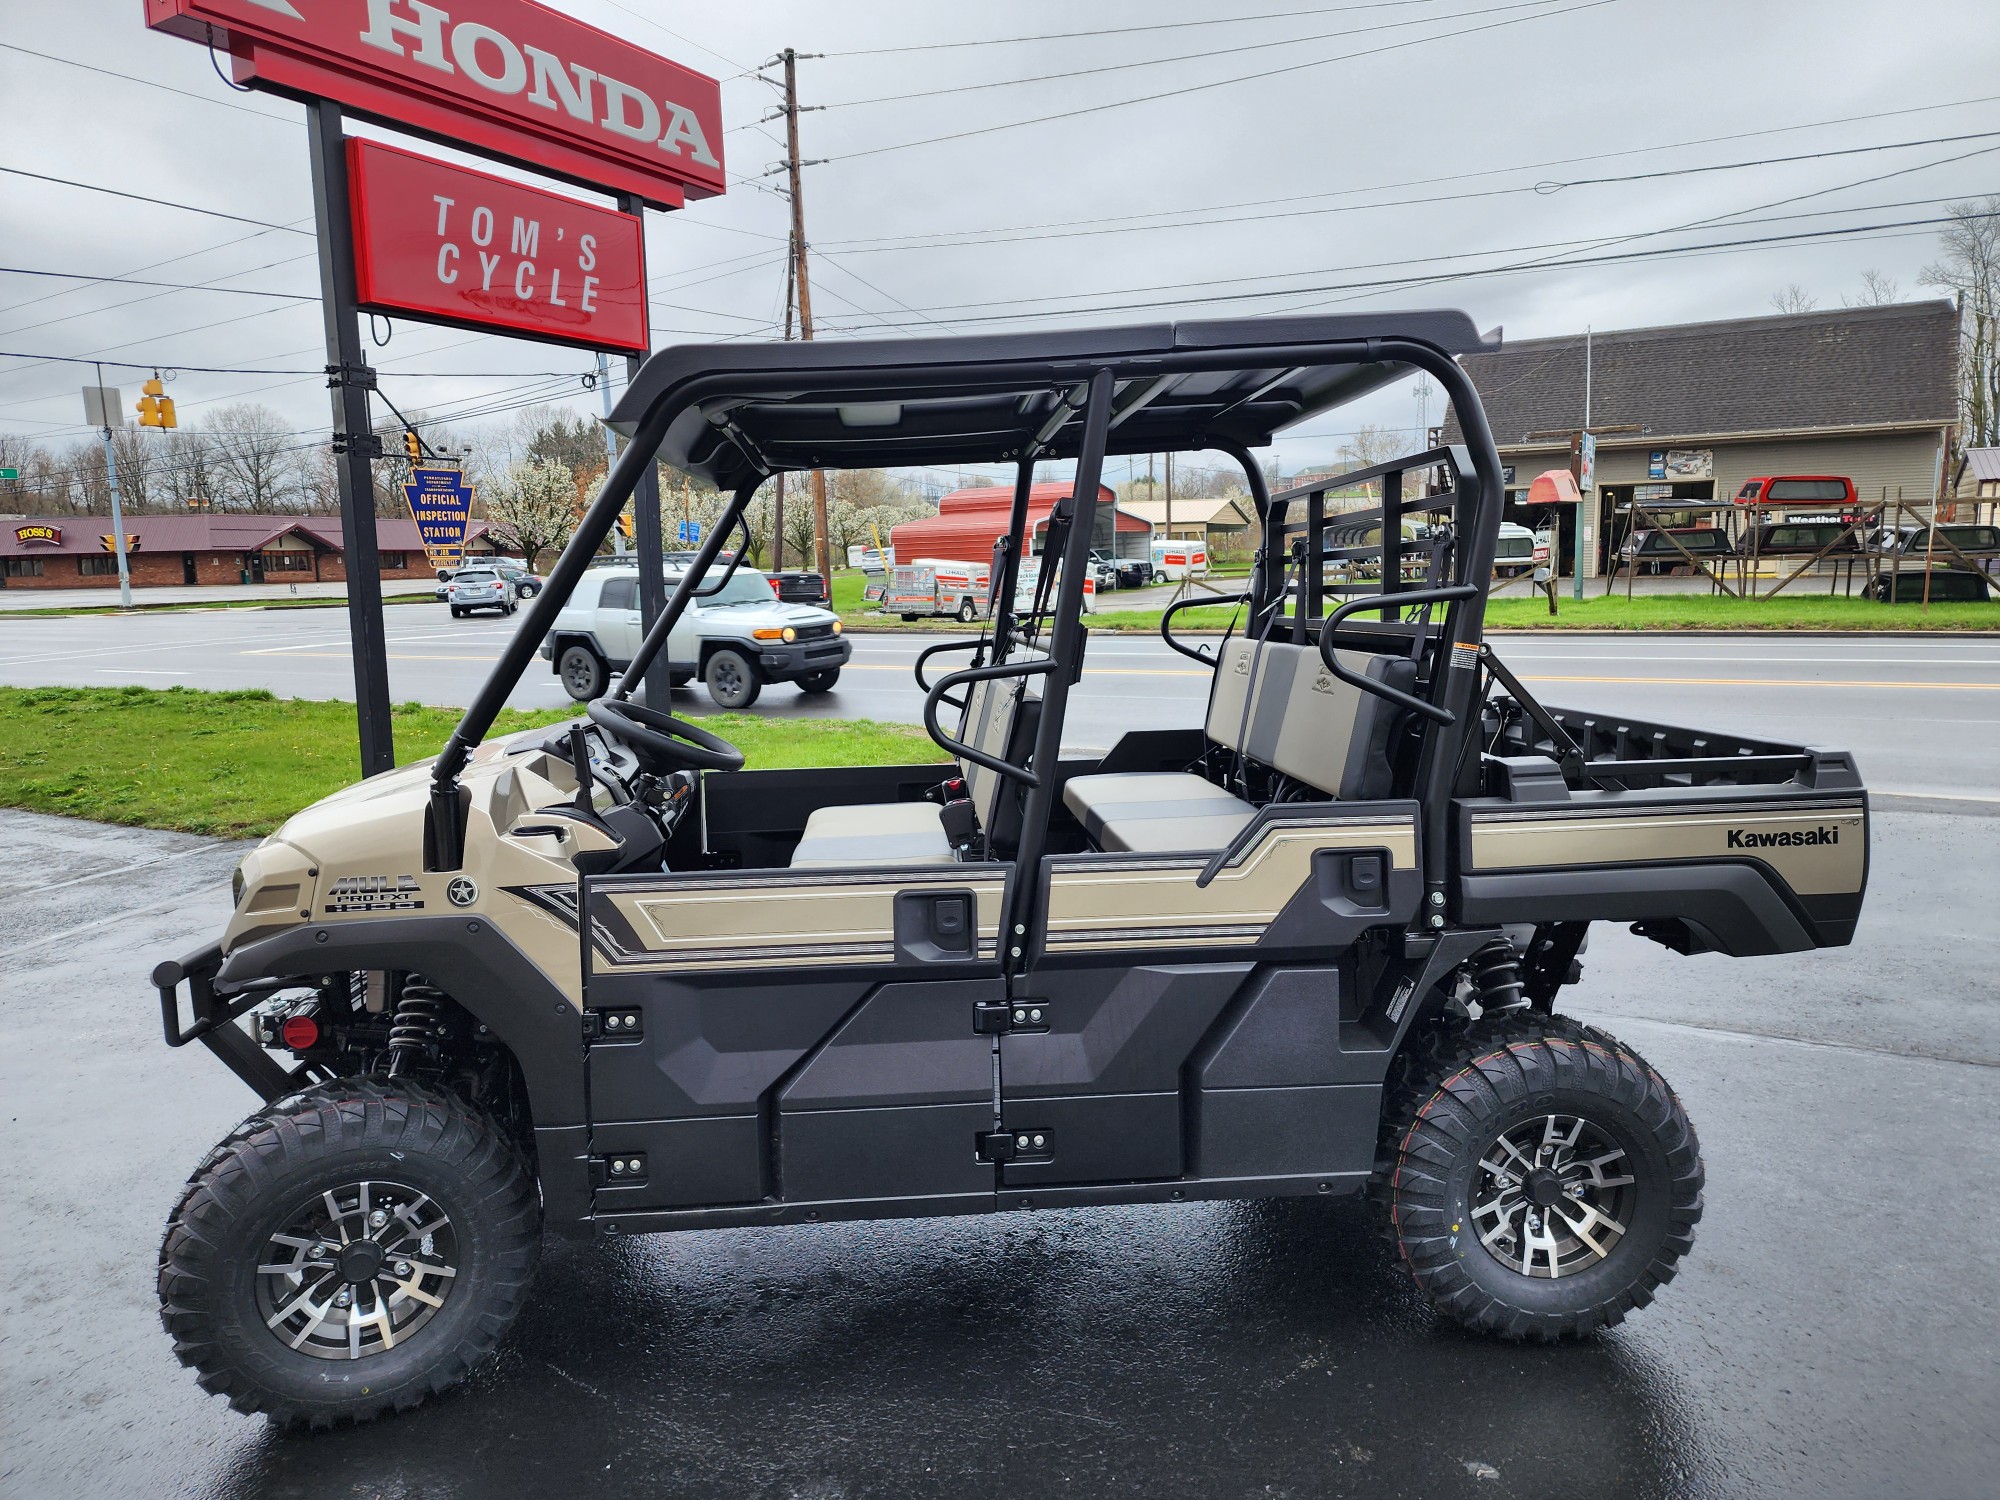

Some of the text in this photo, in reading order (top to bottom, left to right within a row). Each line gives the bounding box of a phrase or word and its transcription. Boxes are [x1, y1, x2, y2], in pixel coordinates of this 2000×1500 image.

[360, 0, 720, 169] HONDA
[433, 194, 597, 271] TOM'S
[437, 243, 599, 312] CYCLE
[420, 494, 461, 505] OFFICIAL
[416, 510, 466, 521] INSPECTION
[18, 527, 53, 540] HOSS'S
[423, 527, 461, 538] STATION
[1727, 826, 1838, 848] Kawasaki
[328, 875, 421, 895] MULE
[336, 893, 412, 902] PRO-FXT
